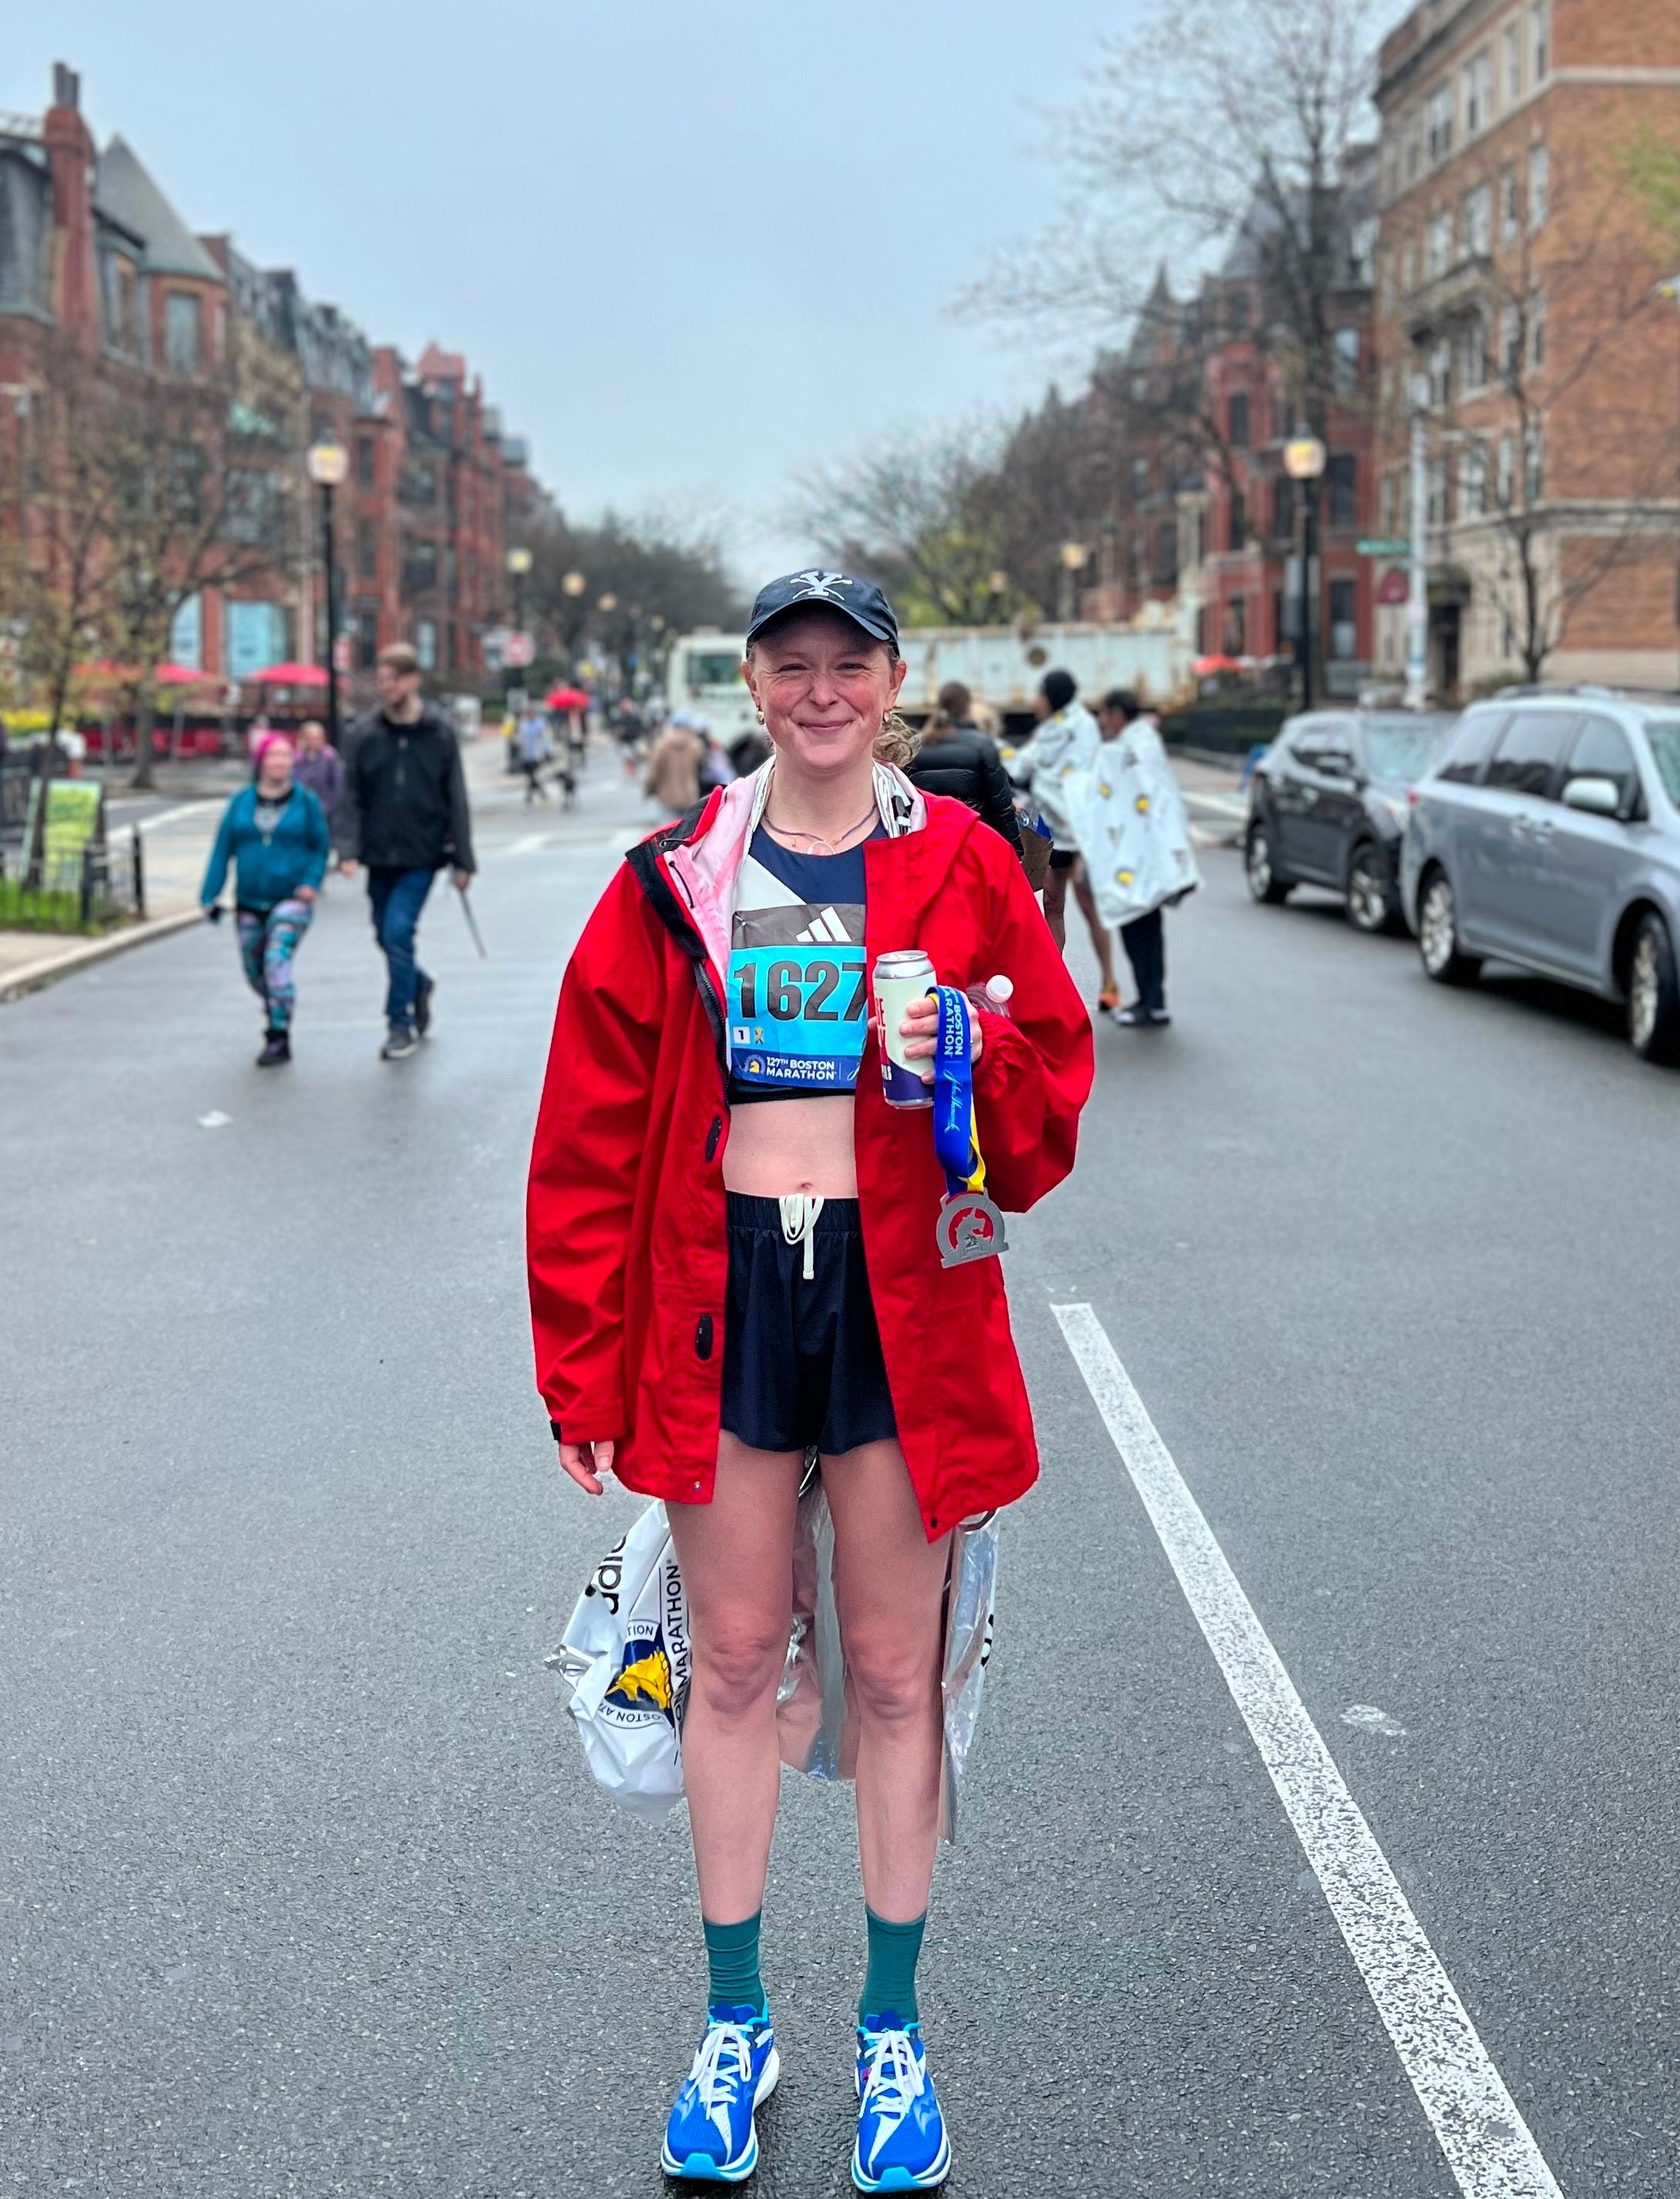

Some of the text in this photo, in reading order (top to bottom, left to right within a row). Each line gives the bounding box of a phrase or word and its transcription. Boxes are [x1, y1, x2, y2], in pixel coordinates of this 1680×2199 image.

[734, 960, 868, 1021] 1627
[943, 986, 956, 1056] ARATHON
[738, 1030, 744, 1041] 1
[954, 1004, 963, 1056] BOSTON
[766, 1057, 789, 1068] 127TH
[789, 1059, 835, 1071] BOSTON
[766, 1067, 835, 1081] MARATHON
[627, 1625, 654, 1636] TION
[666, 1565, 688, 1688] MARATHON
[616, 1710, 661, 1723] OSTON
